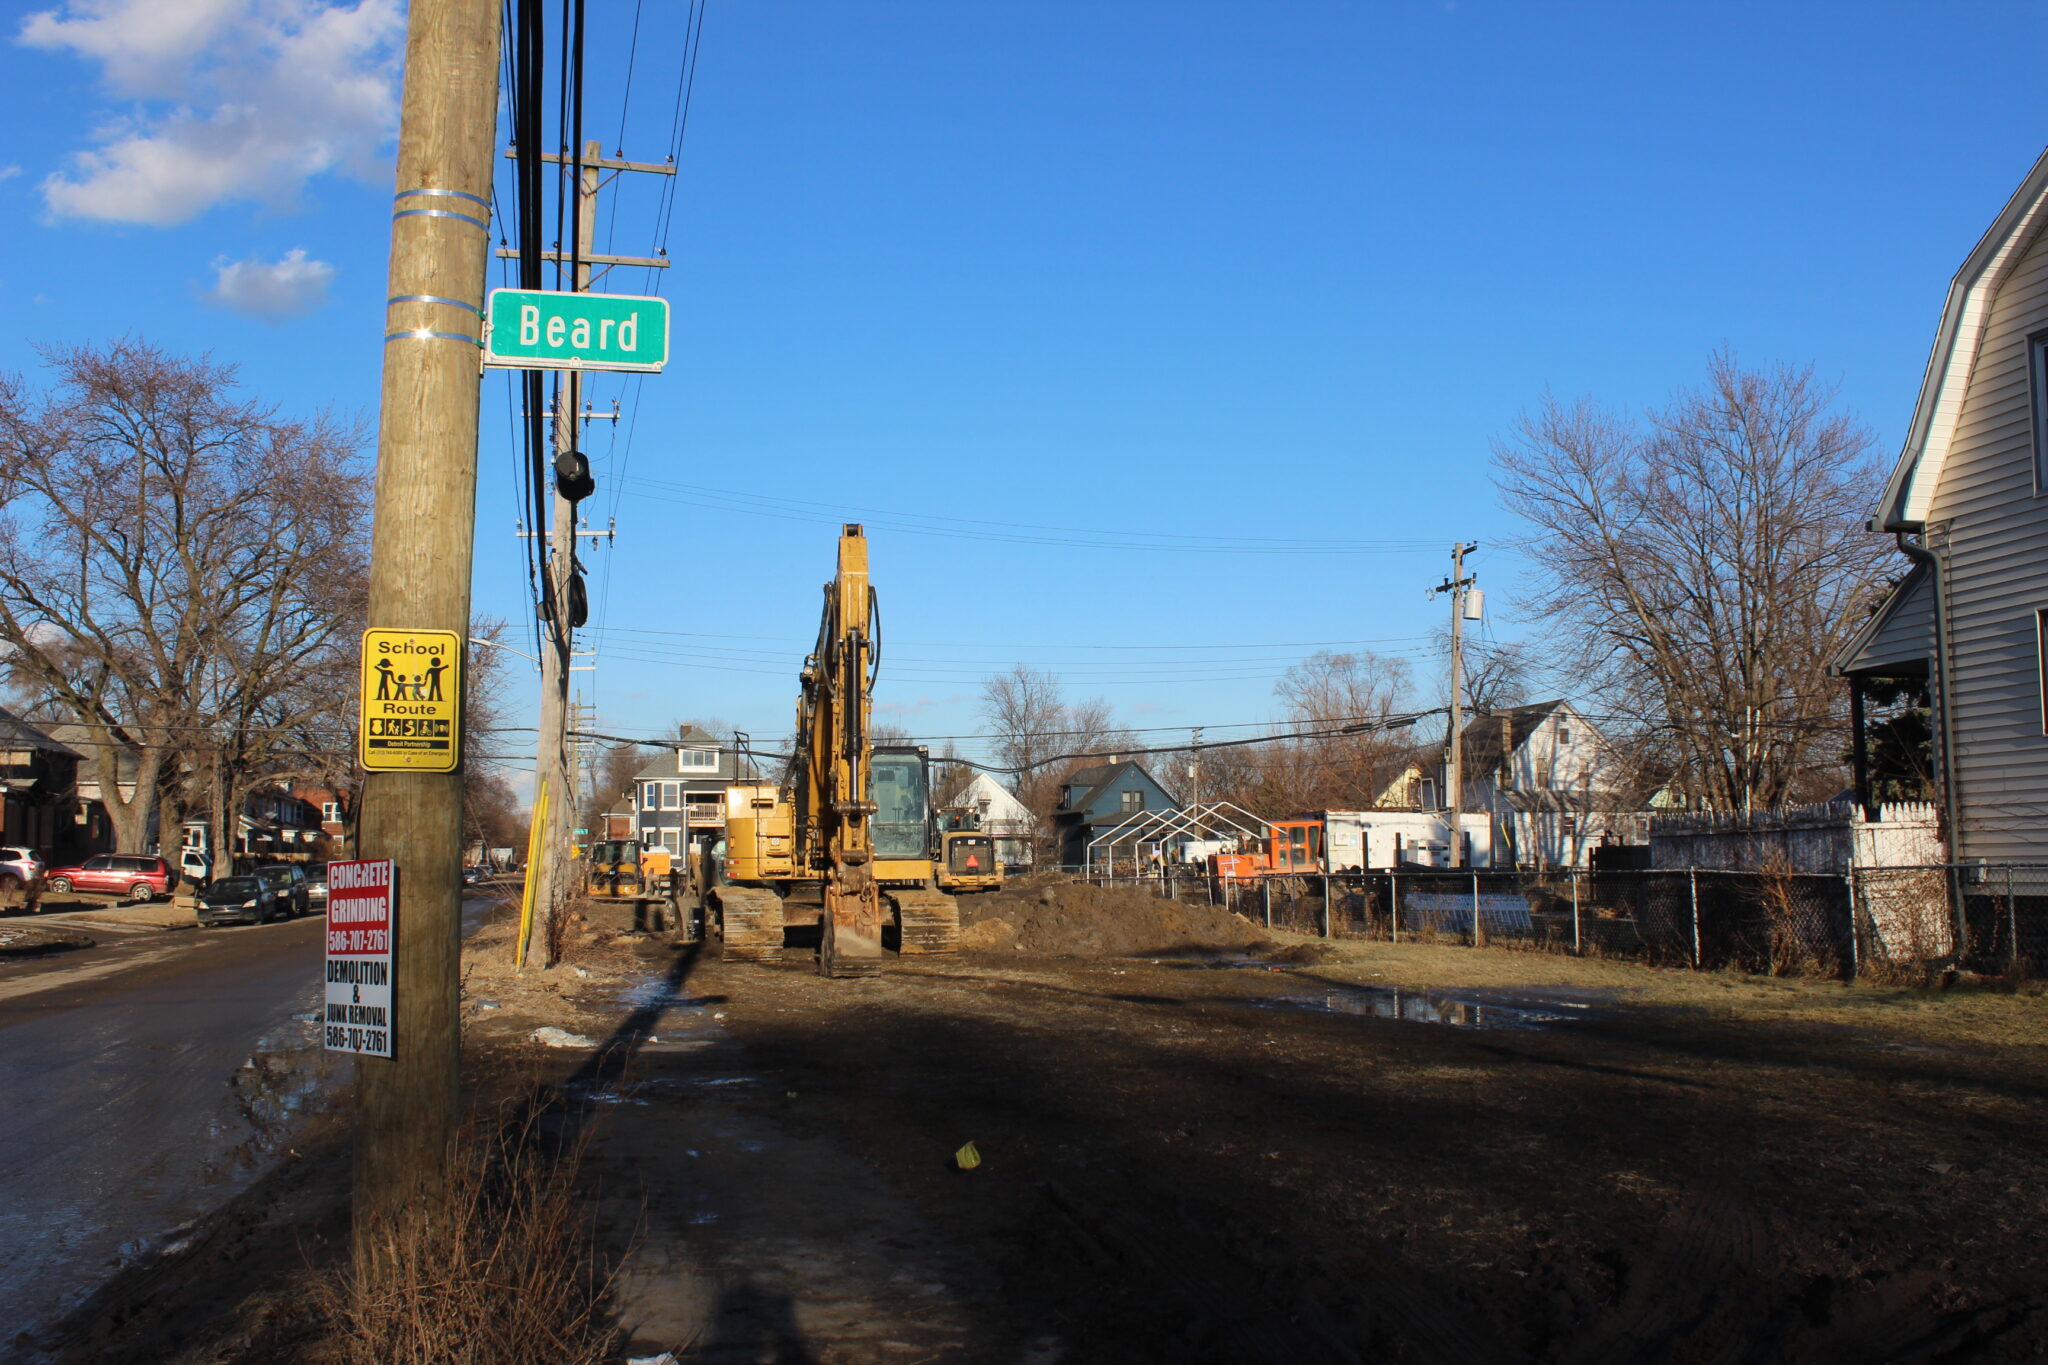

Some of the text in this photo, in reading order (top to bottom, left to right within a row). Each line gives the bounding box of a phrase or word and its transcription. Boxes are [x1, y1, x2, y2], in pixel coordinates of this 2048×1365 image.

[519, 304, 638, 352] Beard
[378, 641, 445, 655] School
[383, 703, 437, 715] Route
[330, 861, 388, 889] CONCRETE
[332, 897, 387, 923] GRINDING
[329, 929, 388, 951] 586-707-2761
[327, 960, 388, 986] DEMOLITION
[352, 984, 361, 1004] &
[327, 1003, 387, 1026] JUNK REMOVAL
[326, 1025, 387, 1053] 586-707-2761
